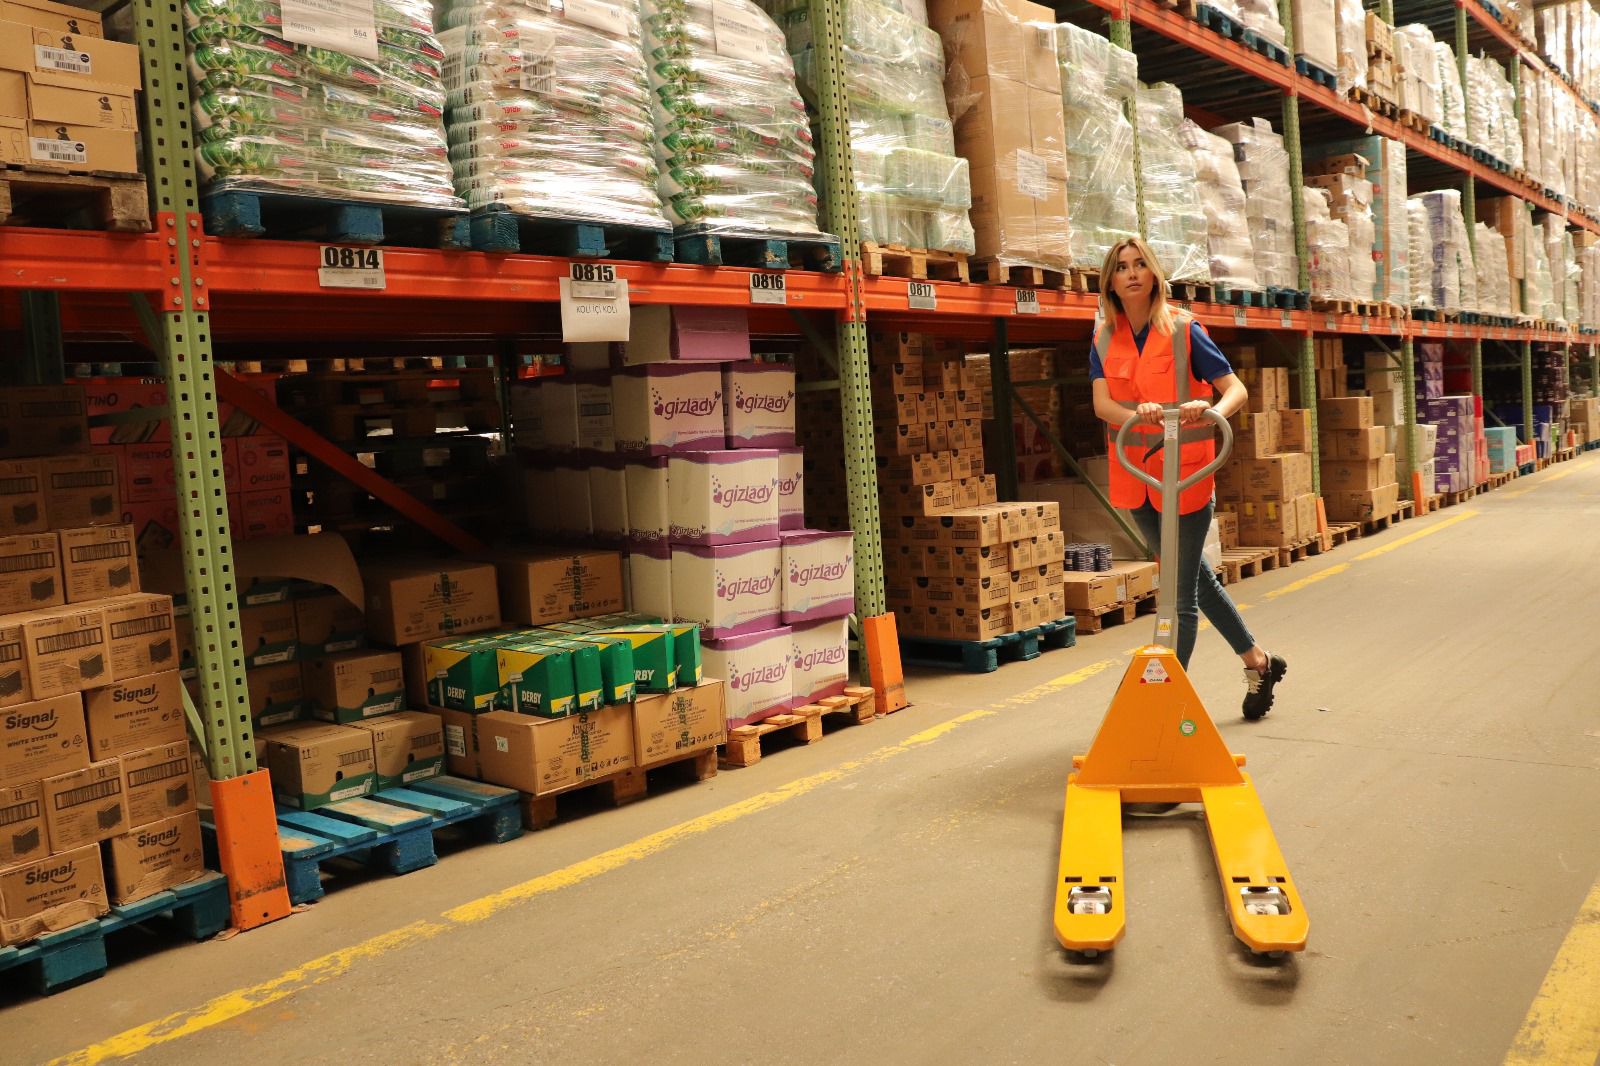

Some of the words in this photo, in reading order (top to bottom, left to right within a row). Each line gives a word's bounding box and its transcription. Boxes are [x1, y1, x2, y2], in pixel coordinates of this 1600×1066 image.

[353, 28, 367, 38] 864
[325, 247, 380, 269] 0814
[573, 264, 614, 282] 0815
[752, 274, 784, 290] 0816
[910, 282, 932, 297] 0817
[1016, 290, 1036, 302] 0818
[664, 398, 717, 420] gizlady
[744, 394, 790, 414] gizlady
[723, 484, 774, 508] gizlady
[800, 562, 848, 586] gizlady
[726, 576, 776, 601] gizlady
[804, 645, 846, 672] gizlady
[634, 670, 655, 681] RBY
[742, 662, 788, 692] gizlady
[113, 684, 156, 702] Signal
[448, 686, 466, 699] DERBY
[522, 690, 542, 704] DERBY
[6, 708, 54, 729] Signal
[114, 712, 134, 720] WHITE
[136, 706, 160, 715] SYSTEM
[8, 738, 30, 748] WHITE
[32, 732, 58, 742] SYSTEM
[137, 826, 178, 848] Signal
[25, 860, 72, 885] Signal
[26, 892, 48, 902] WHITE
[50, 884, 77, 896] SYSTEM
